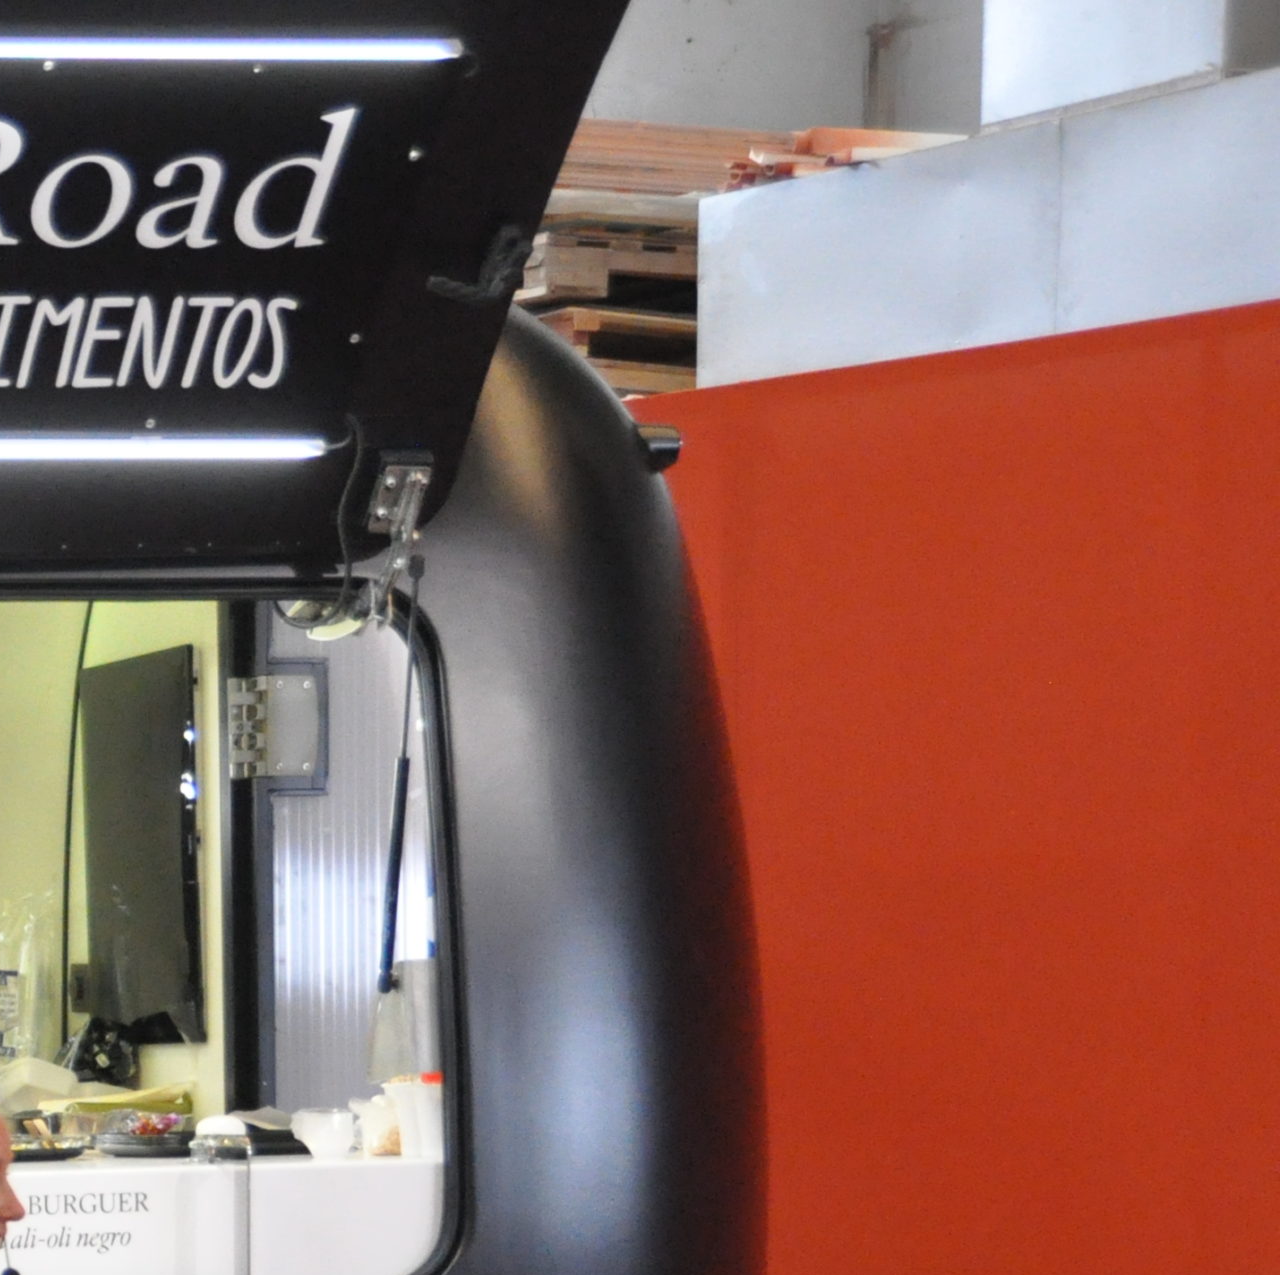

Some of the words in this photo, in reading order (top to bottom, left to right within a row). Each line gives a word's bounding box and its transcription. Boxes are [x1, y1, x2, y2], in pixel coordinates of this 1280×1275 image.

[28, 1192, 149, 1215] BURGUER
[10, 1226, 71, 1249] ali-oli
[77, 1230, 131, 1254] negro
